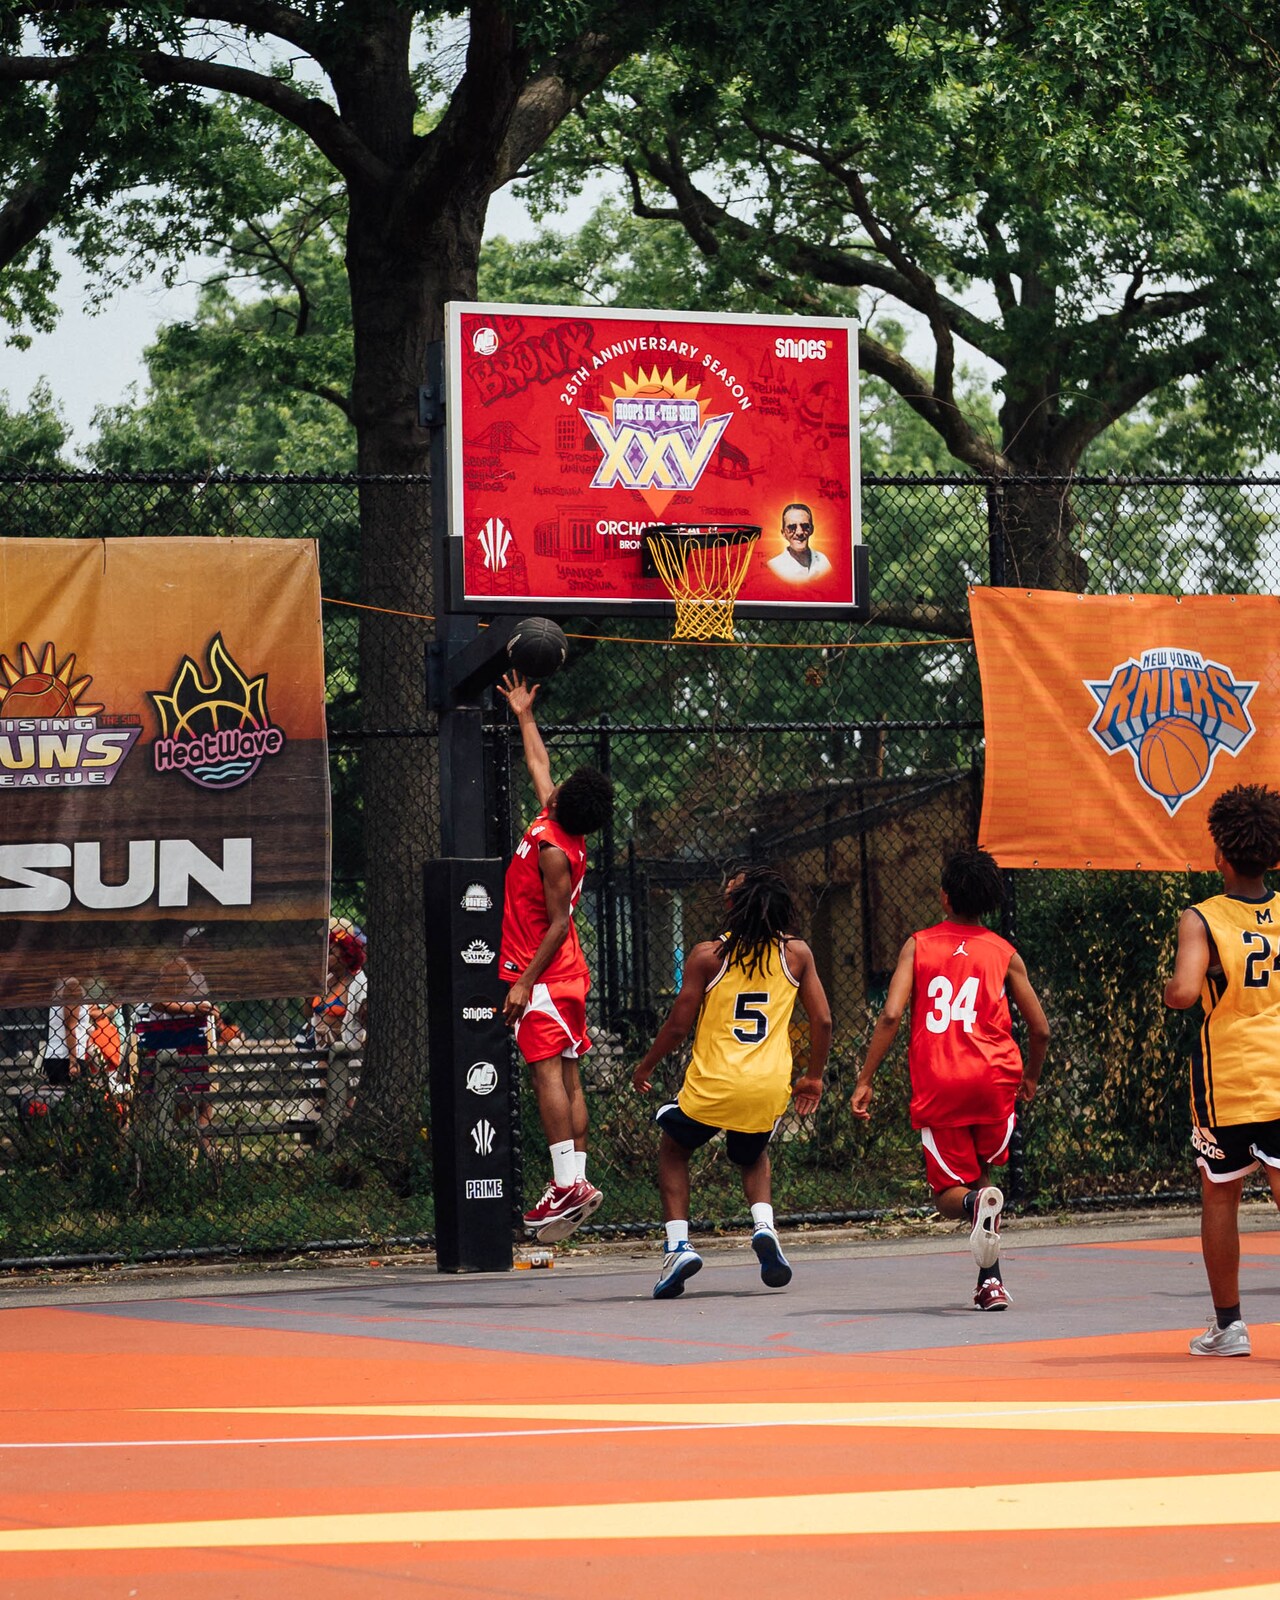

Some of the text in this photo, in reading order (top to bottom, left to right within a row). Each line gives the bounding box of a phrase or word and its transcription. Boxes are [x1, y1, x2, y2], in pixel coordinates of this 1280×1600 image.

[560, 336, 752, 411] 25TH ANNIVERSARY SEASON
[577, 407, 734, 490] XXV
[1142, 651, 1202, 669] NEW YORK
[6, 719, 93, 732] ISING
[1095, 664, 1251, 746] KNICKS
[0, 733, 131, 769] UNS
[0, 772, 106, 785] EAGUE
[0, 836, 252, 912] SUN
[1254, 908, 1274, 926] M
[1241, 930, 1280, 989] 2
[733, 991, 770, 1044] 5
[926, 975, 980, 1034] 34
[466, 1179, 503, 1199] PRIME
